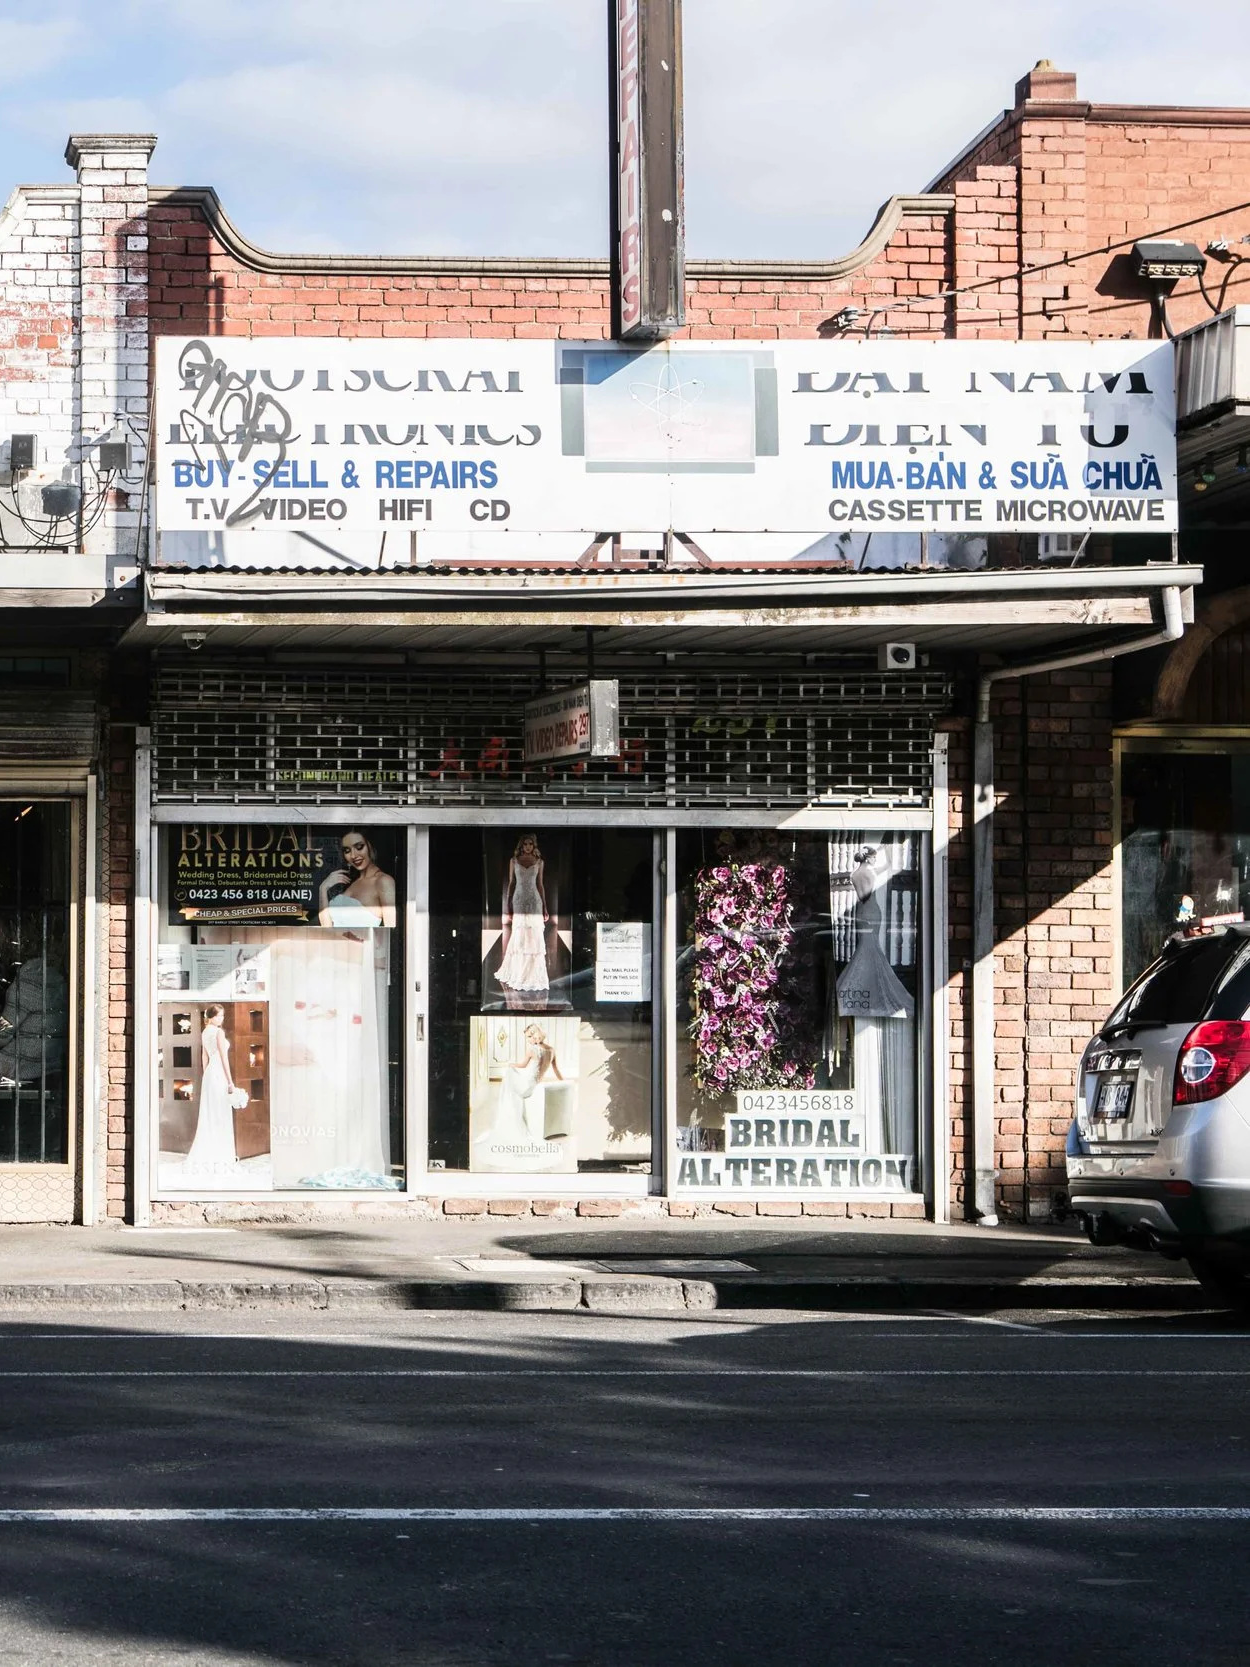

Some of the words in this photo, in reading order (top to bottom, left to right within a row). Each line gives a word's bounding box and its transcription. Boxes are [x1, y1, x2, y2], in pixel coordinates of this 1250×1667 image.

[619, 0, 639, 322] EPAIRS
[341, 459, 361, 489] &
[375, 459, 499, 489] REPAIRS
[978, 460, 998, 490] &
[258, 497, 348, 521] VIDEO
[378, 498, 433, 521] HIFI
[469, 498, 511, 522] CD
[828, 499, 983, 522] CASSETTE
[996, 499, 1165, 522] MICROWAVE
[555, 719, 578, 747] REPAIRS
[278, 771, 321, 781] SECON
[359, 771, 404, 781] DEALE
[181, 824, 324, 852] BRIDAL
[177, 852, 325, 868] ALTERATIONS
[178, 871, 215, 880] Wedding
[217, 871, 242, 879] Dress,
[243, 871, 288, 879] Bridesmaid
[290, 871, 313, 879] Dress
[189, 889, 218, 900] 0423
[221, 889, 244, 900] 456
[246, 889, 269, 900] 818
[272, 889, 313, 901] (JANE)
[194, 910, 223, 918] CHEAP
[231, 907, 266, 916] SPECIAL
[267, 905, 298, 914] PRICES
[743, 1095, 854, 1111] 0423456818
[729, 1119, 860, 1148] BRIDAL
[490, 1142, 560, 1154] cosmobella
[676, 1157, 908, 1187] ALTERATION
